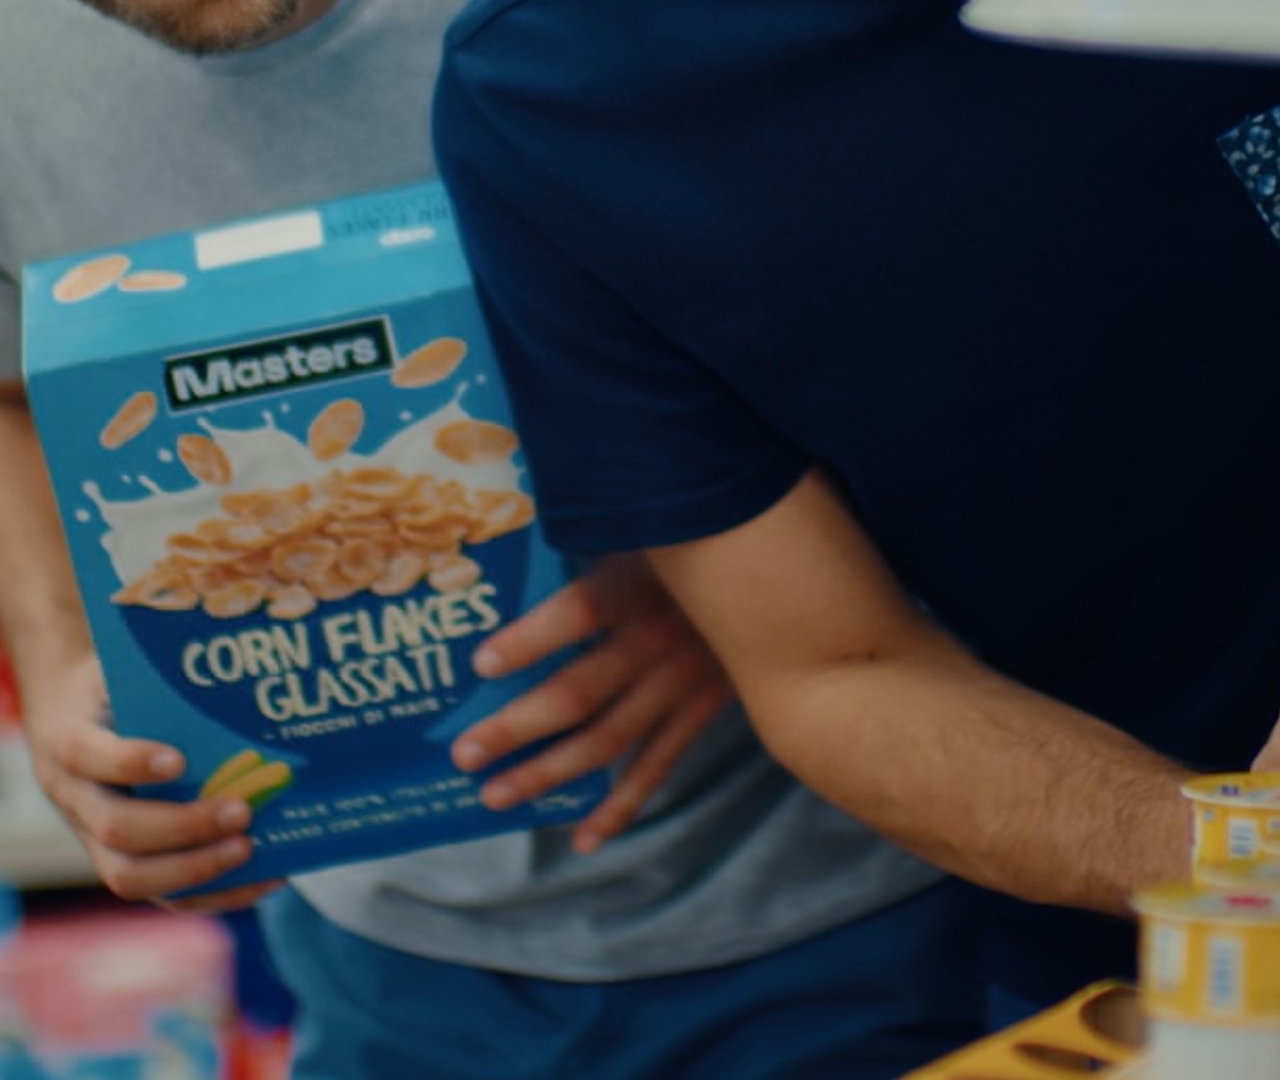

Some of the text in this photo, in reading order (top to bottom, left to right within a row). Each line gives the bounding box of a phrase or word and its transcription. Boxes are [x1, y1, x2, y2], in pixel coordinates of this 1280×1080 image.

[171, 337, 378, 402] Masters
[182, 583, 501, 687] CORN FLAKES
[254, 643, 455, 721] GLASSATI
[363, 709, 383, 725] DI
